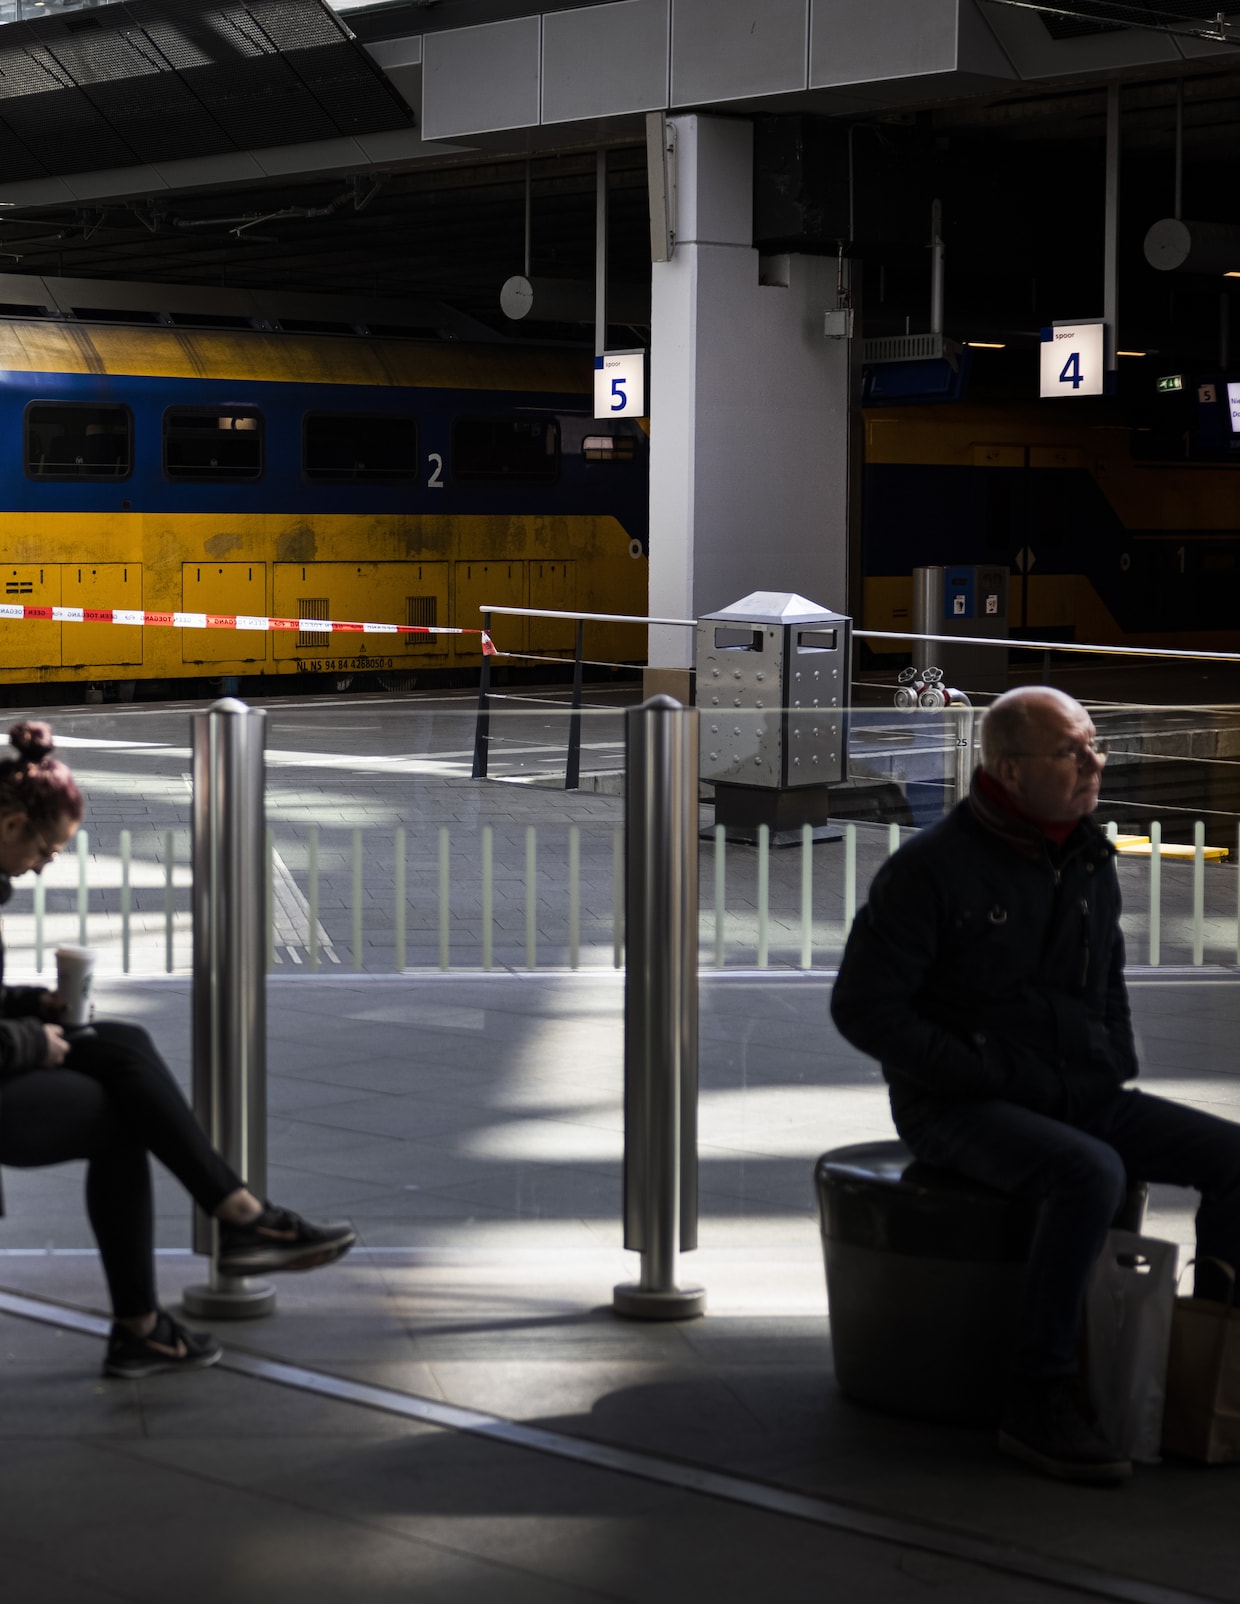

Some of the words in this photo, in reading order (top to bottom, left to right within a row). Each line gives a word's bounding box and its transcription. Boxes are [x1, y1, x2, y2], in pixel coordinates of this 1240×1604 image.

[1055, 332, 1075, 340] spoor
[1059, 352, 1084, 389] 4
[611, 378, 627, 411] 5
[1204, 391, 1211, 401] 5
[427, 453, 444, 488] 2
[1176, 545, 1185, 574] 1
[311, 660, 322, 670] NS
[325, 660, 335, 669] 94
[338, 660, 348, 669] 84
